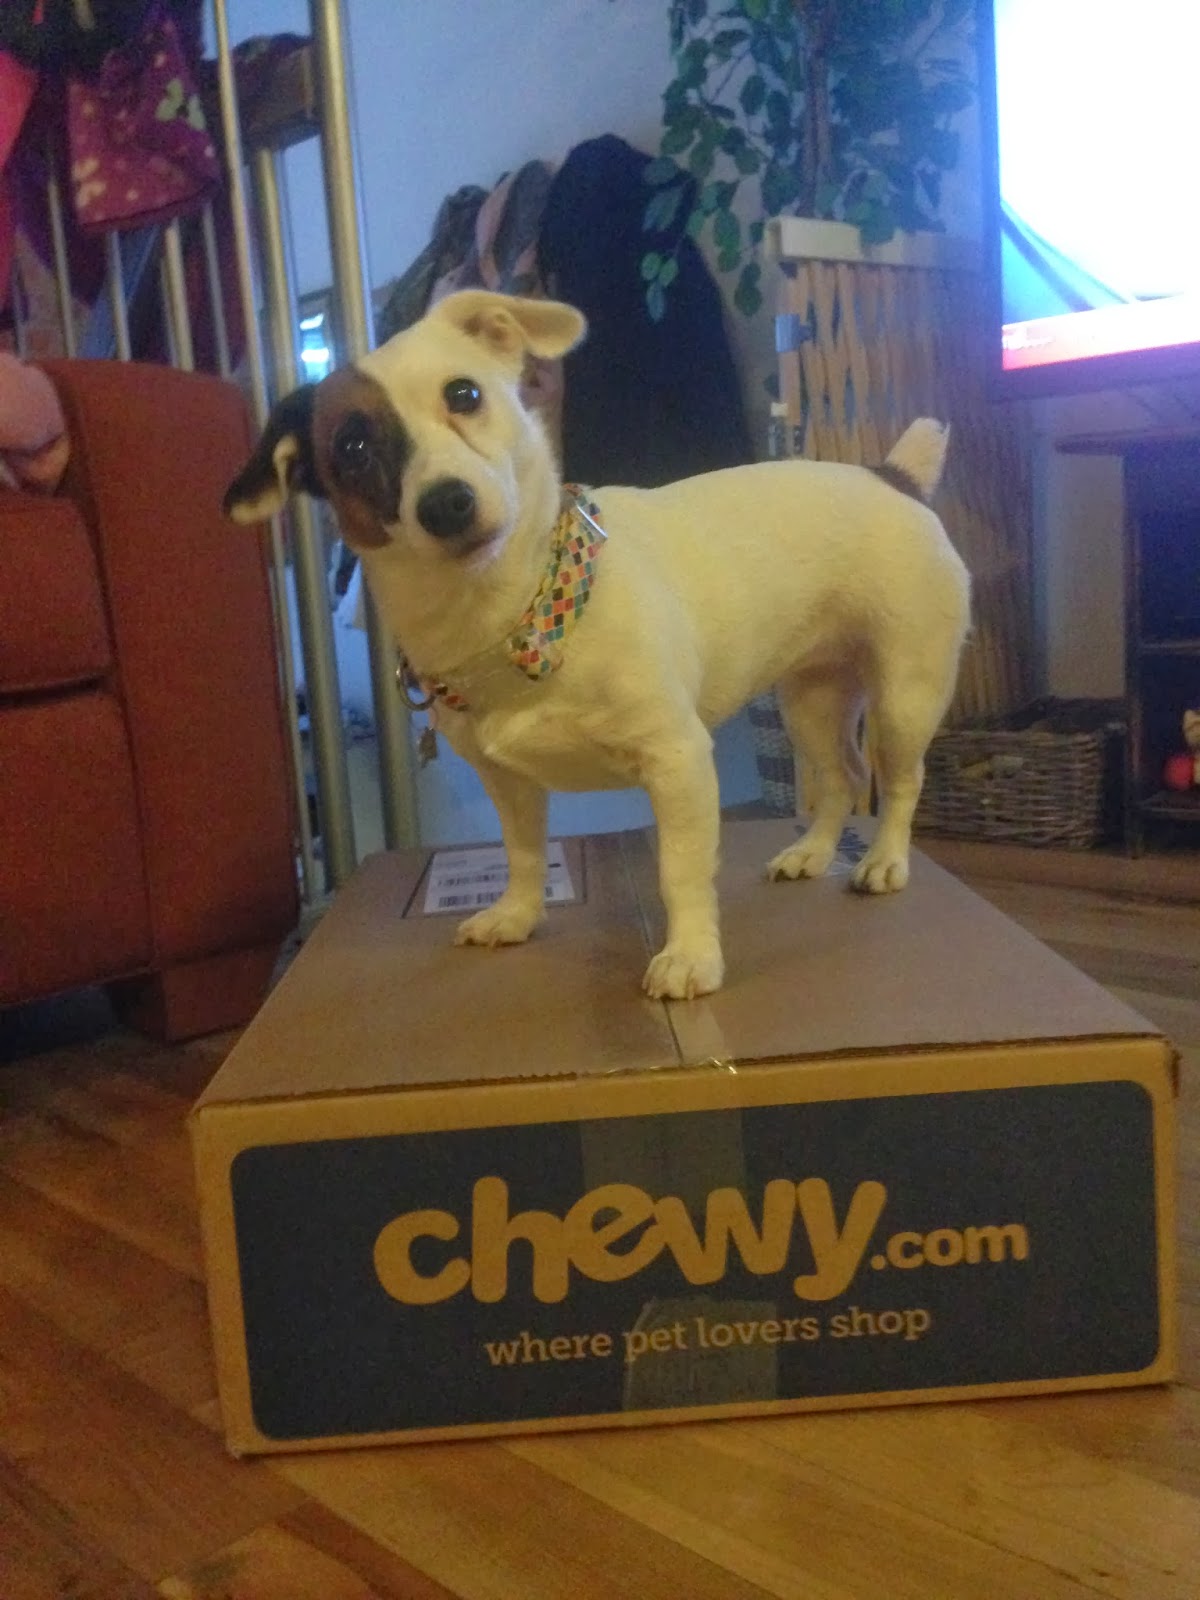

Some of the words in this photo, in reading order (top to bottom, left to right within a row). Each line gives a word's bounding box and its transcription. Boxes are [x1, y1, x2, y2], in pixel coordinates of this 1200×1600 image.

[373, 1175, 1030, 1306] chewy.com
[484, 1330, 612, 1366] where
[622, 1322, 687, 1364] pet
[697, 1315, 821, 1349] lovers
[829, 1306, 931, 1341] shop
